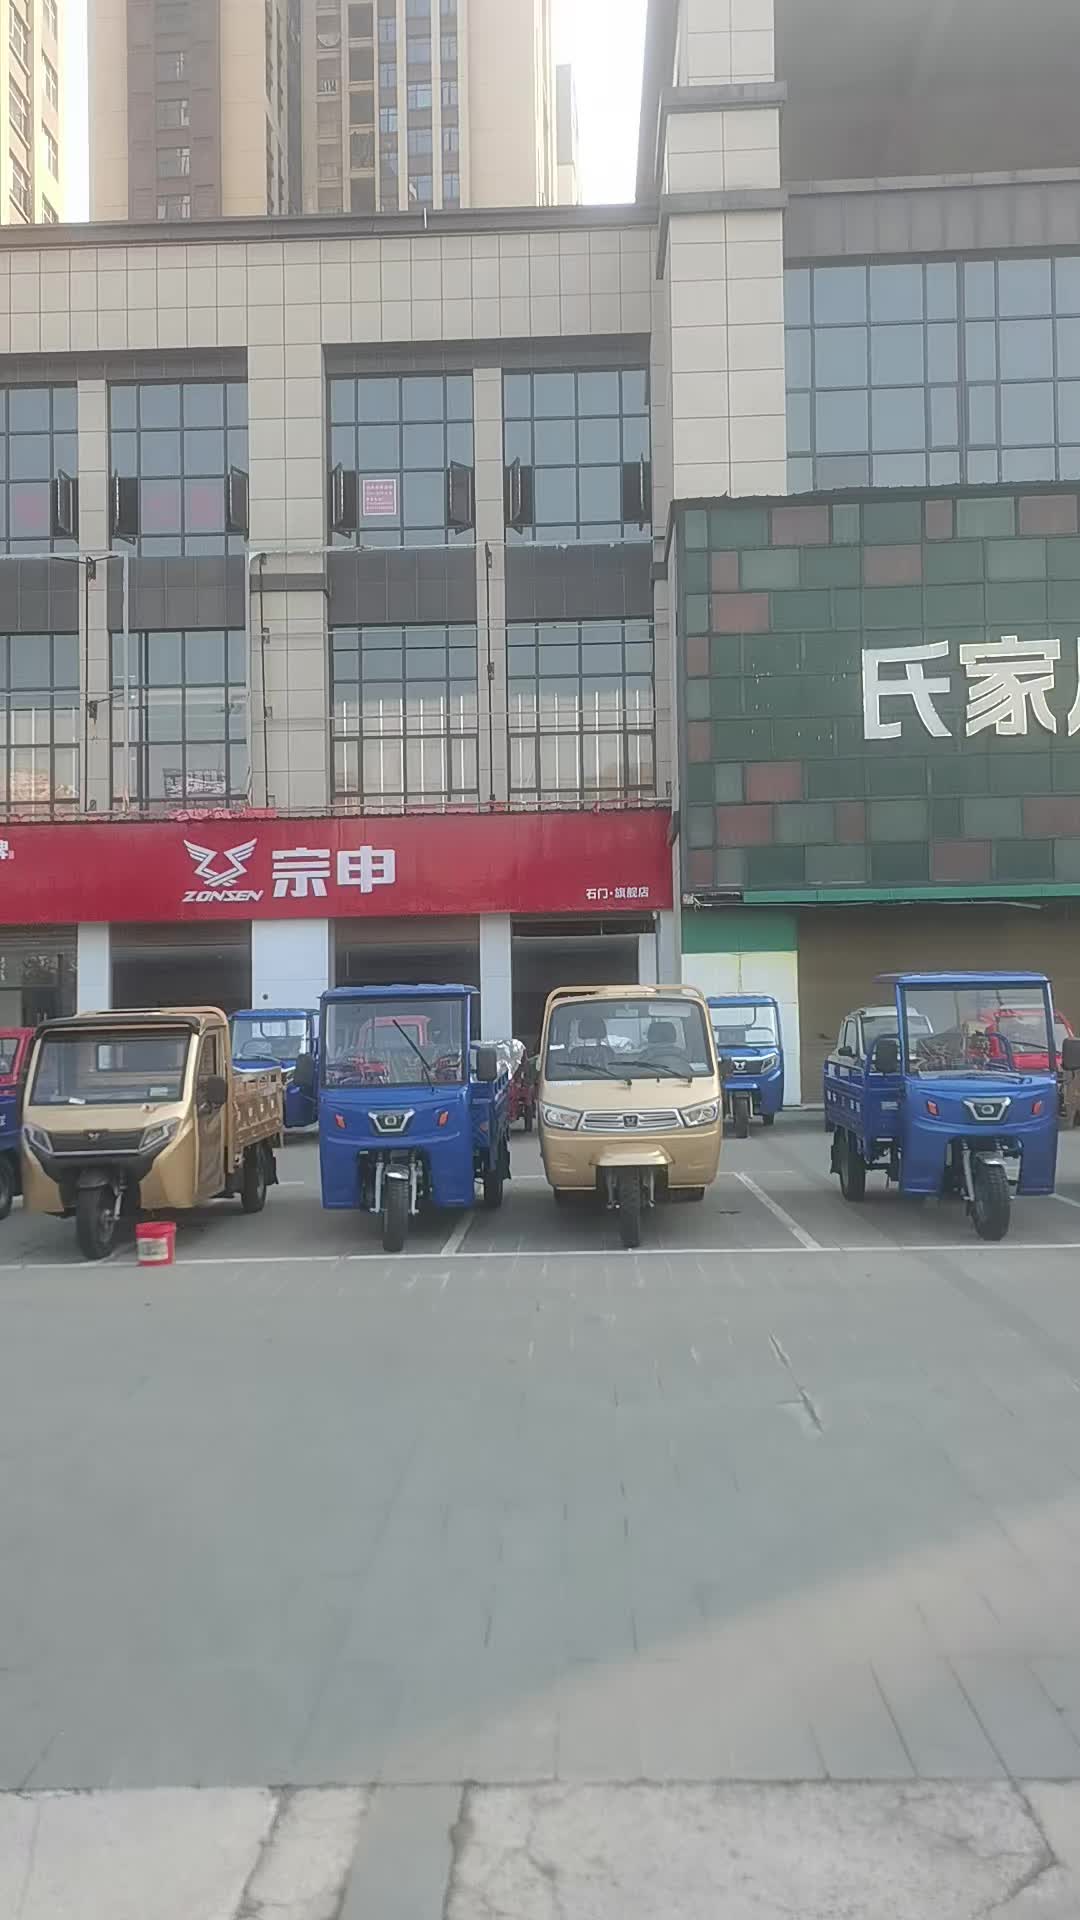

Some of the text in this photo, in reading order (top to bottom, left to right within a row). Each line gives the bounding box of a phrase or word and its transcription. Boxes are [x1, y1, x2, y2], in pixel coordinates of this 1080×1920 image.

[861, 635, 1080, 740] 氏家
[181, 889, 264, 903] ZONSEN
[271, 845, 396, 898] 宗申
